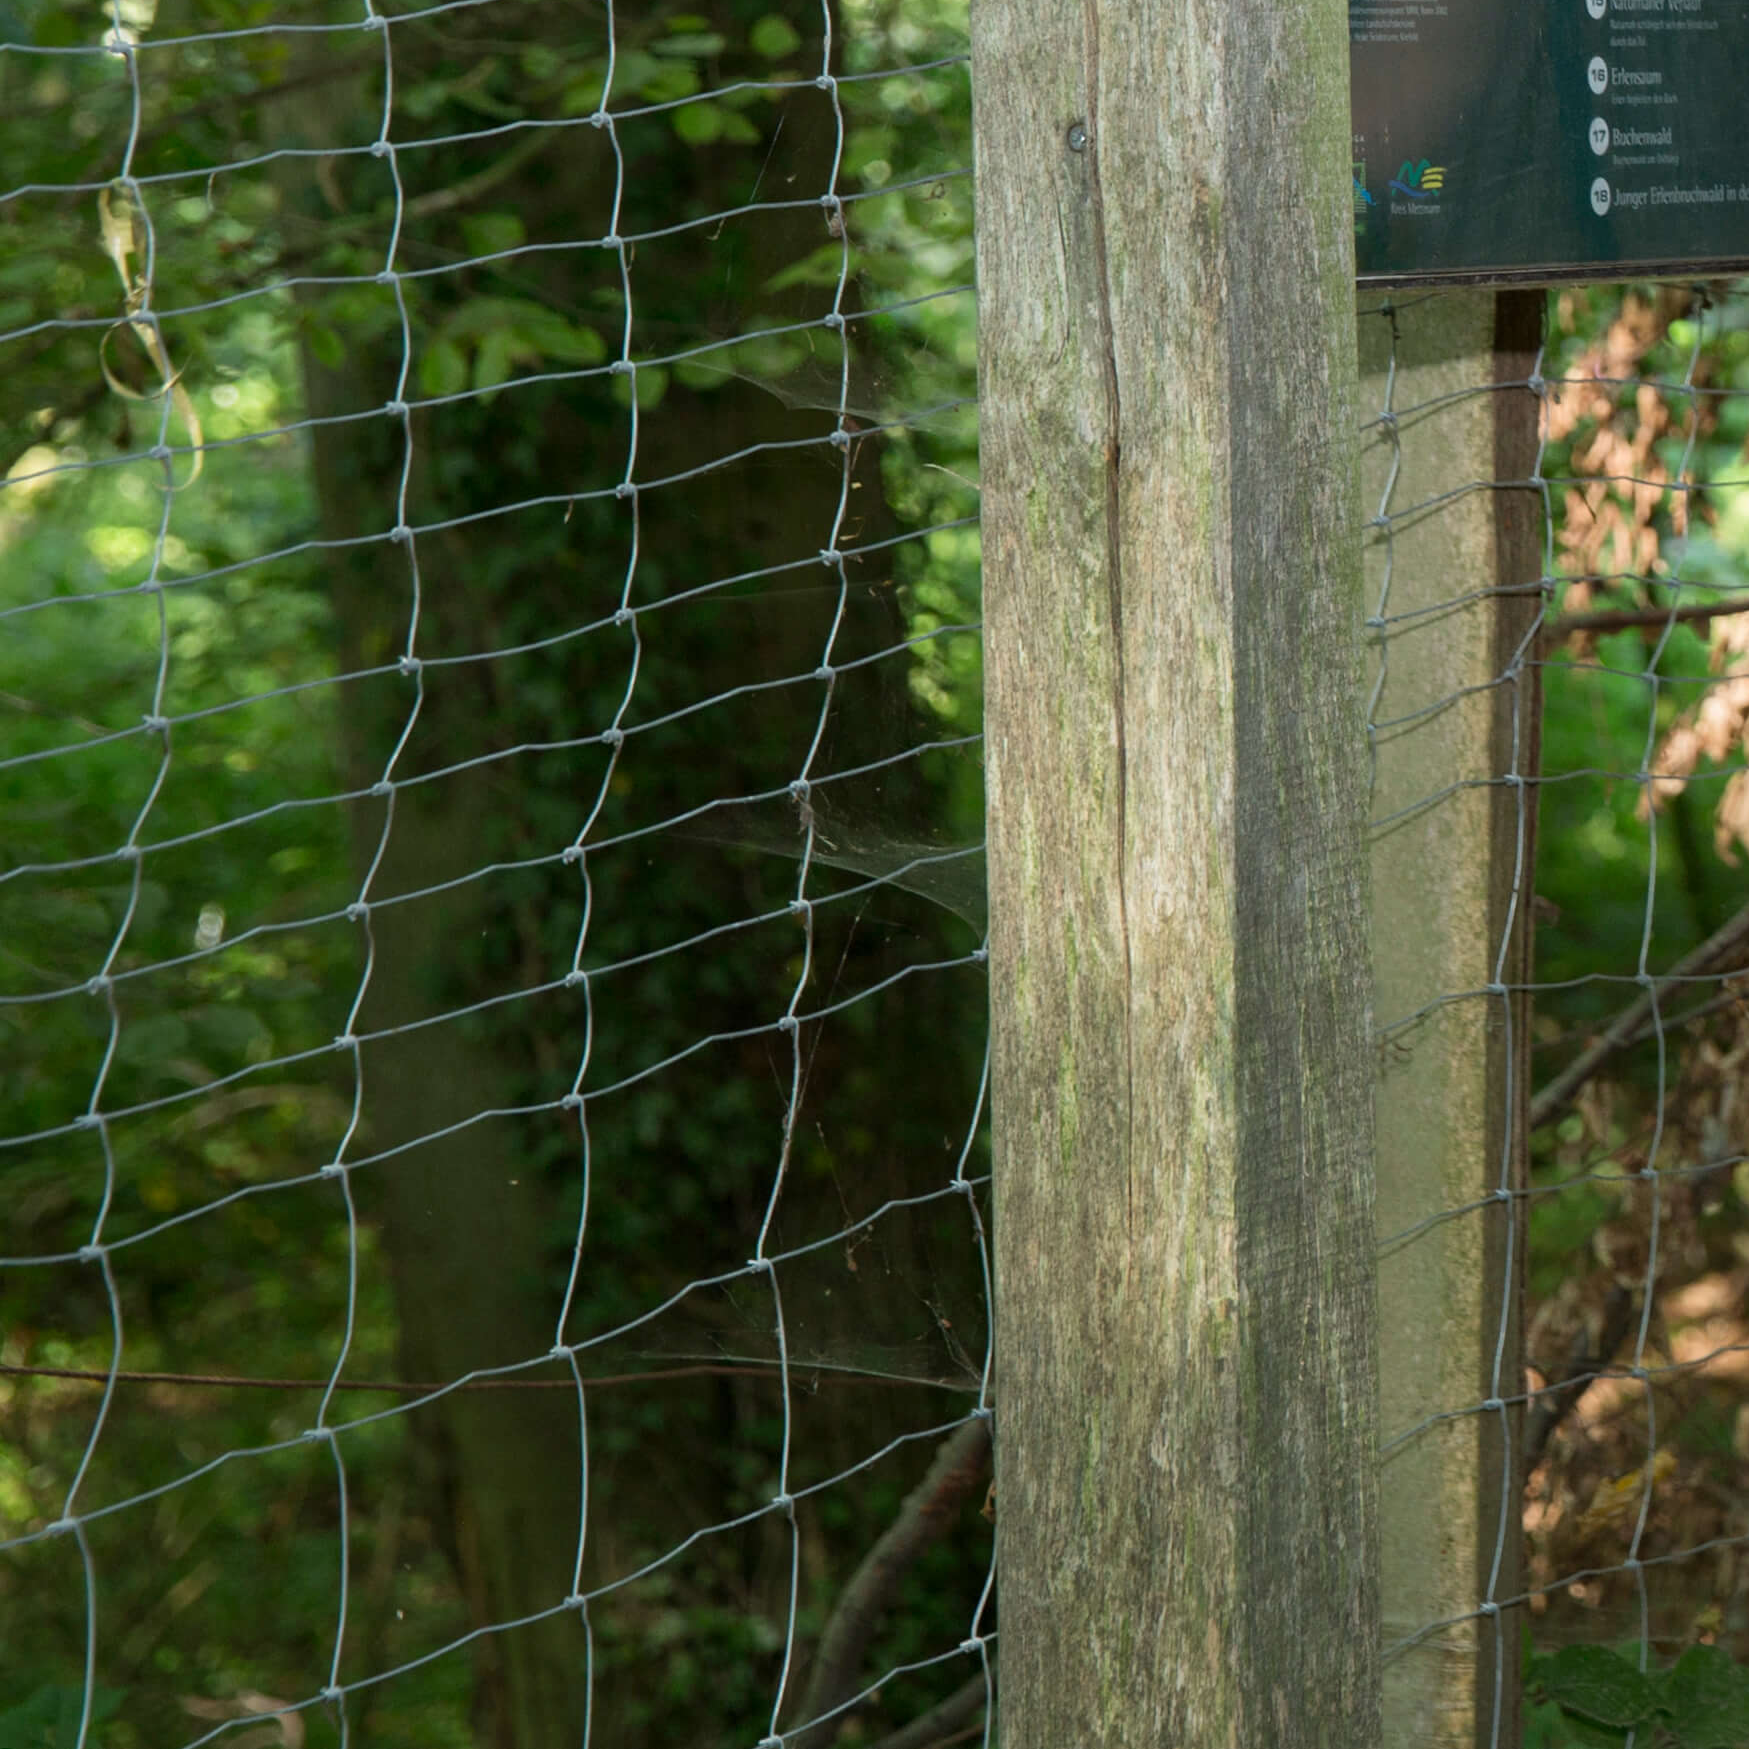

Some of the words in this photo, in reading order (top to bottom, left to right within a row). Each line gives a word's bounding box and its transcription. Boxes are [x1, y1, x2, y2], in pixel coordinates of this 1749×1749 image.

[1611, 67, 1662, 86] Erlensaum
[1612, 127, 1673, 147] Buchenwald
[1613, 188, 1649, 209] Junger
[1726, 183, 1738, 201] in
